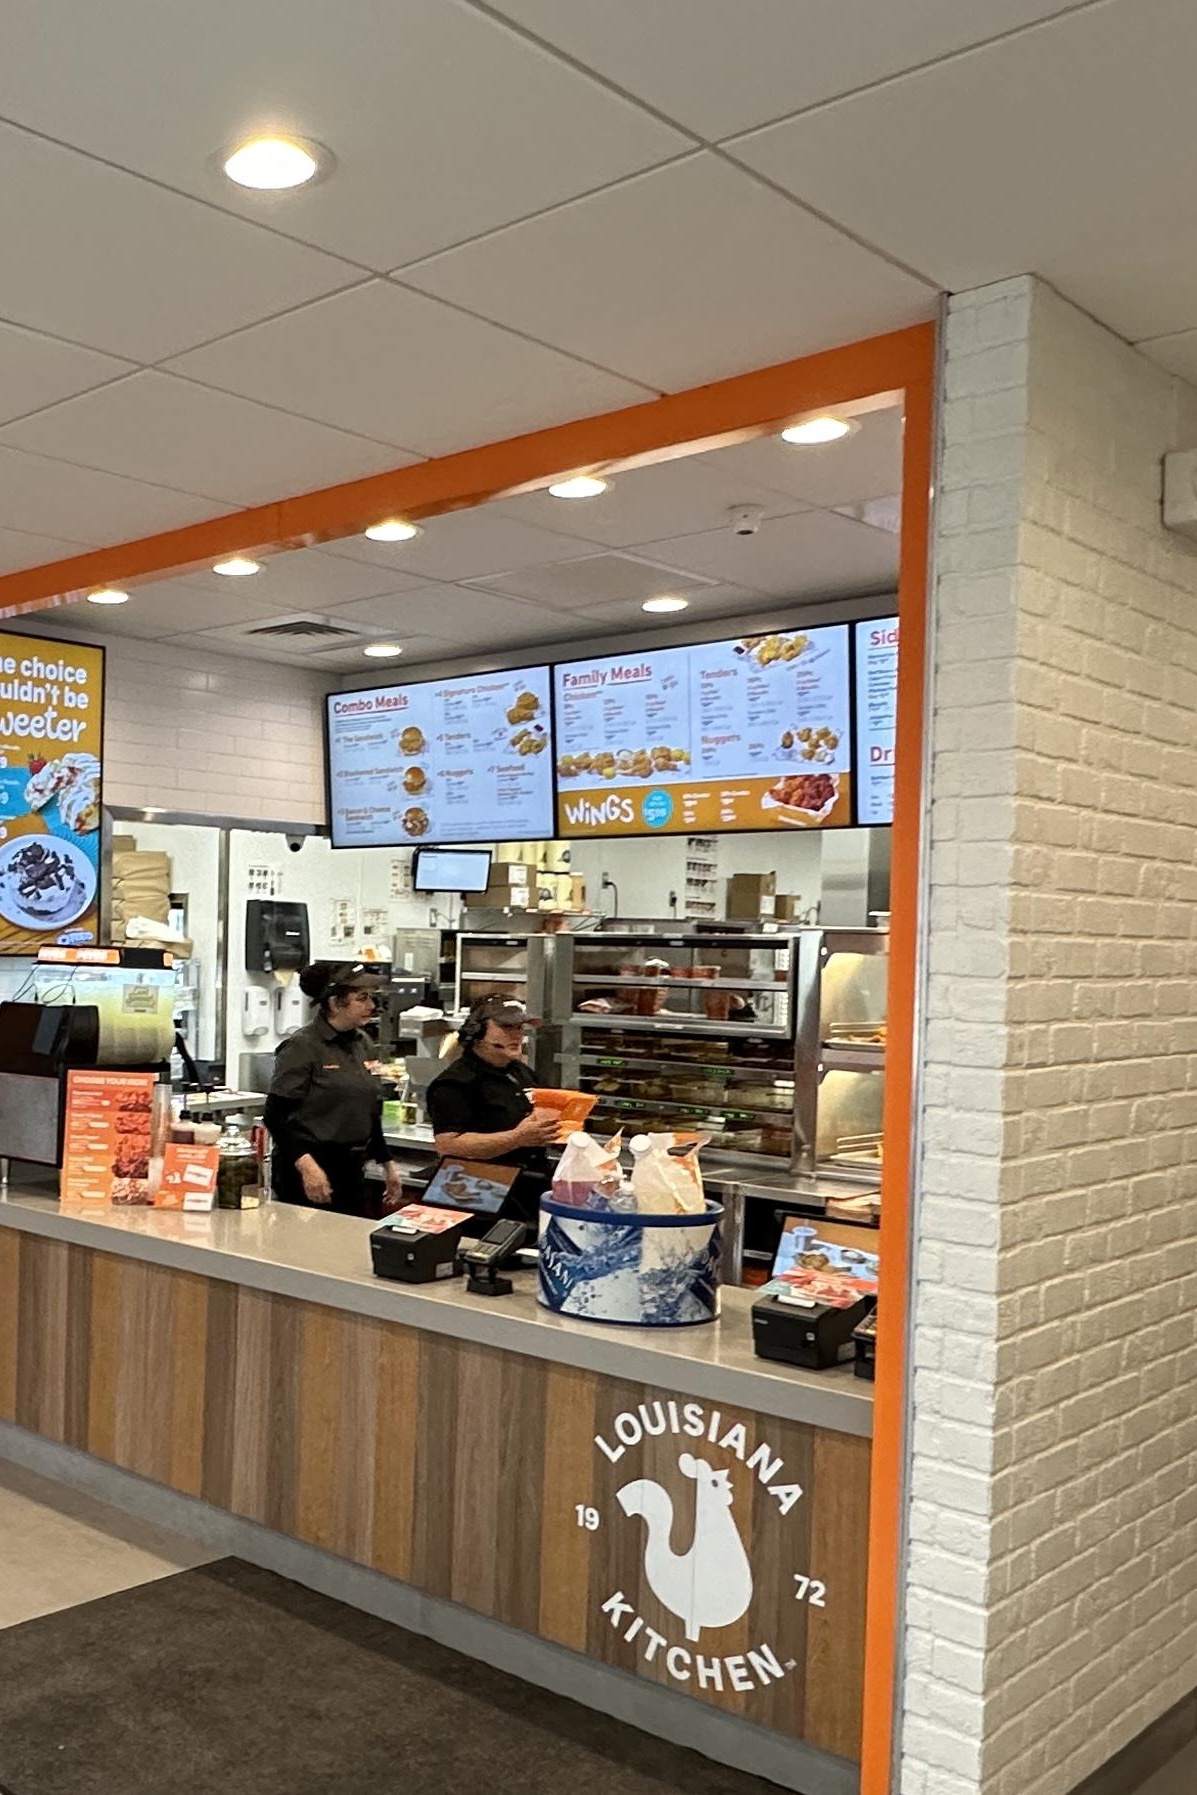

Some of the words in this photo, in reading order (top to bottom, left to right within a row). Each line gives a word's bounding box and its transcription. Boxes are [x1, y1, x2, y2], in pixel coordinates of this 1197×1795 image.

[20, 656, 87, 684] choice
[563, 670, 607, 687] Family
[611, 663, 653, 681] Meals
[64, 686, 89, 709] be
[333, 698, 373, 714] Combo
[375, 694, 408, 708] Meals
[594, 1400, 804, 1516] LOUISIANA
[575, 1504, 600, 1531] 19
[793, 1573, 826, 1608] 72
[601, 1591, 785, 1692] KITCHEN
